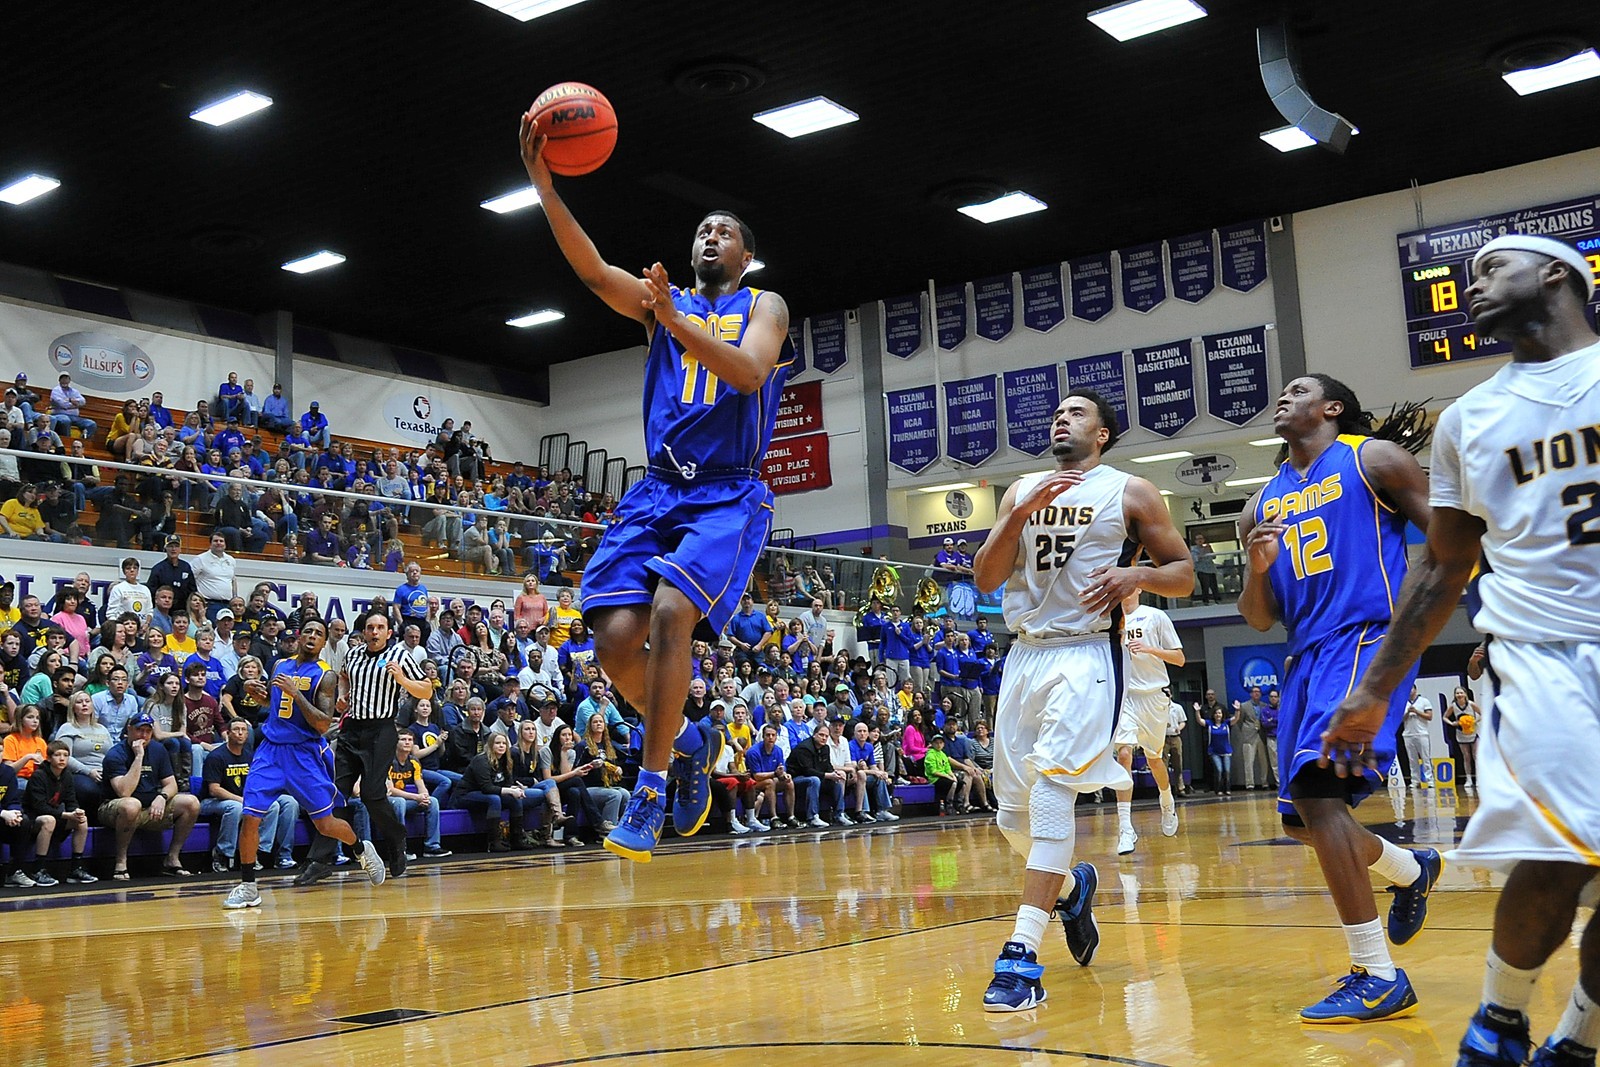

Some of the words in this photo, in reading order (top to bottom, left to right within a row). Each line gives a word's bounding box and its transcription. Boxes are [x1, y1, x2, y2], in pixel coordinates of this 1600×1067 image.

[551, 106, 596, 125] NCAA
[1477, 218, 1507, 229] Home
[1509, 213, 1521, 223] of
[1523, 210, 1539, 220] the
[1429, 228, 1493, 255] TEXANS
[1514, 208, 1594, 238] TEXANNS
[1413, 265, 1451, 281] LIONS
[1431, 280, 1458, 313] 18
[1216, 334, 1253, 349] TEXANN
[1418, 329, 1447, 343] FOULS
[1463, 334, 1476, 350] 4
[1145, 347, 1180, 362] TEXANN
[1208, 344, 1263, 361] BASKETBALL
[1434, 338, 1450, 361] 4
[83, 354, 123, 375] ALLSUP'S
[1079, 361, 1111, 374] TEXANN
[1137, 356, 1190, 373] BASKETBALL
[1228, 362, 1244, 371] NCAA
[681, 350, 719, 406] 11
[1015, 373, 1047, 386] TEXANN
[1070, 369, 1122, 385] BASKETBALL
[1220, 368, 1255, 380] TOURNAMENT
[957, 383, 984, 395] TEXANN
[1007, 381, 1055, 397] BASKETBALL
[1154, 380, 1176, 393] NCAA
[1224, 377, 1250, 387] REGIONAL
[899, 392, 925, 404] TEXANN
[949, 391, 994, 407] BASKETBALL
[1141, 388, 1192, 406] TOURNAMENT
[891, 400, 935, 415] BASKETBALL
[962, 409, 981, 420] NCAA
[1223, 407, 1256, 418] 2013-2014
[394, 416, 443, 435] TexasBan
[773, 418, 798, 430] IVISION
[904, 417, 923, 428] NCAA
[950, 420, 996, 435] TOURNAMENT
[1024, 416, 1053, 427] TOURNAME
[1154, 418, 1185, 429] 2012-2013
[893, 428, 936, 443] TOURNAMENT
[1027, 433, 1043, 441] 25-5
[763, 447, 792, 460] ATIONAL
[787, 459, 810, 471] PLACE
[1181, 464, 1222, 477] RESTROMS
[1029, 506, 1094, 526] IONS
[927, 520, 967, 535] TEXANS
[1035, 534, 1076, 572] 25
[1283, 517, 1334, 581] 12
[1244, 674, 1278, 687] NCAA
[278, 690, 294, 719] 3
